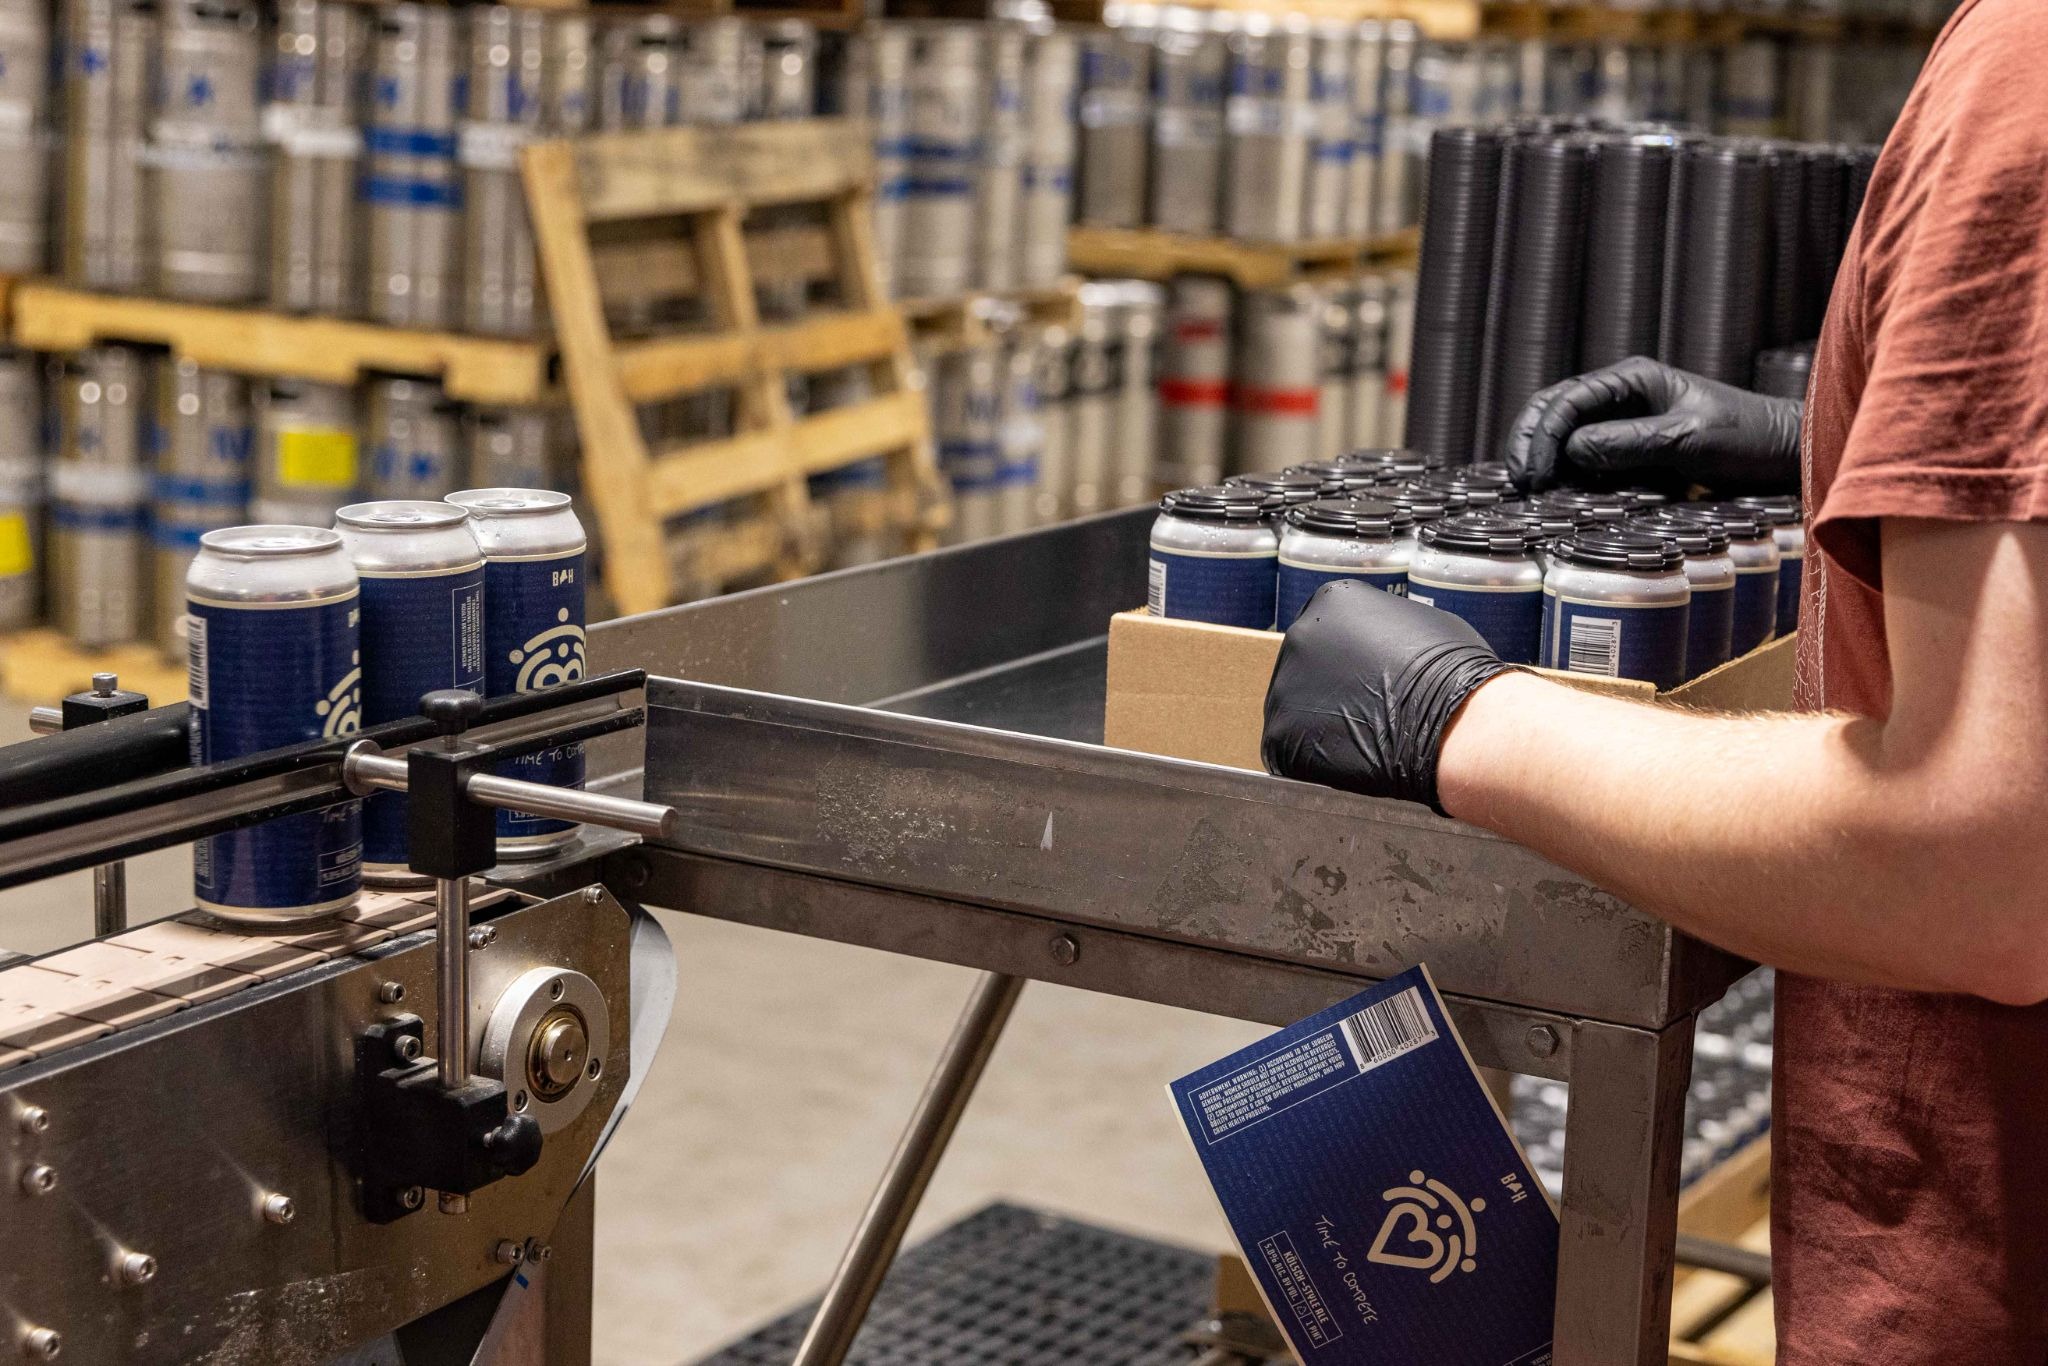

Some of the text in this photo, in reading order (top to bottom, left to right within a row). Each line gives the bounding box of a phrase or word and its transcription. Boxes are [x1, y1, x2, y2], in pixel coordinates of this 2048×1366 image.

[547, 747, 563, 762] TO
[1223, 1083, 1242, 1096] WOMEN
[1258, 1070, 1269, 1080] NOT
[1283, 1051, 1310, 1068] ALCOHOLIC
[1309, 1039, 1336, 1056] BEVERAGES
[1372, 1047, 1397, 1063] 60000
[1399, 1036, 1423, 1051] 40287
[1197, 1080, 1231, 1100] GOVERNMENT
[1293, 1047, 1301, 1055] TO
[1301, 1042, 1311, 1052] THE
[1263, 1242, 1279, 1263] 5.0%
[1281, 1275, 1292, 1287] BY
[1315, 1214, 1379, 1325] TIME TO COMPETE
[1307, 1324, 1322, 1342] PINT
[1314, 1307, 1329, 1324] ALE
